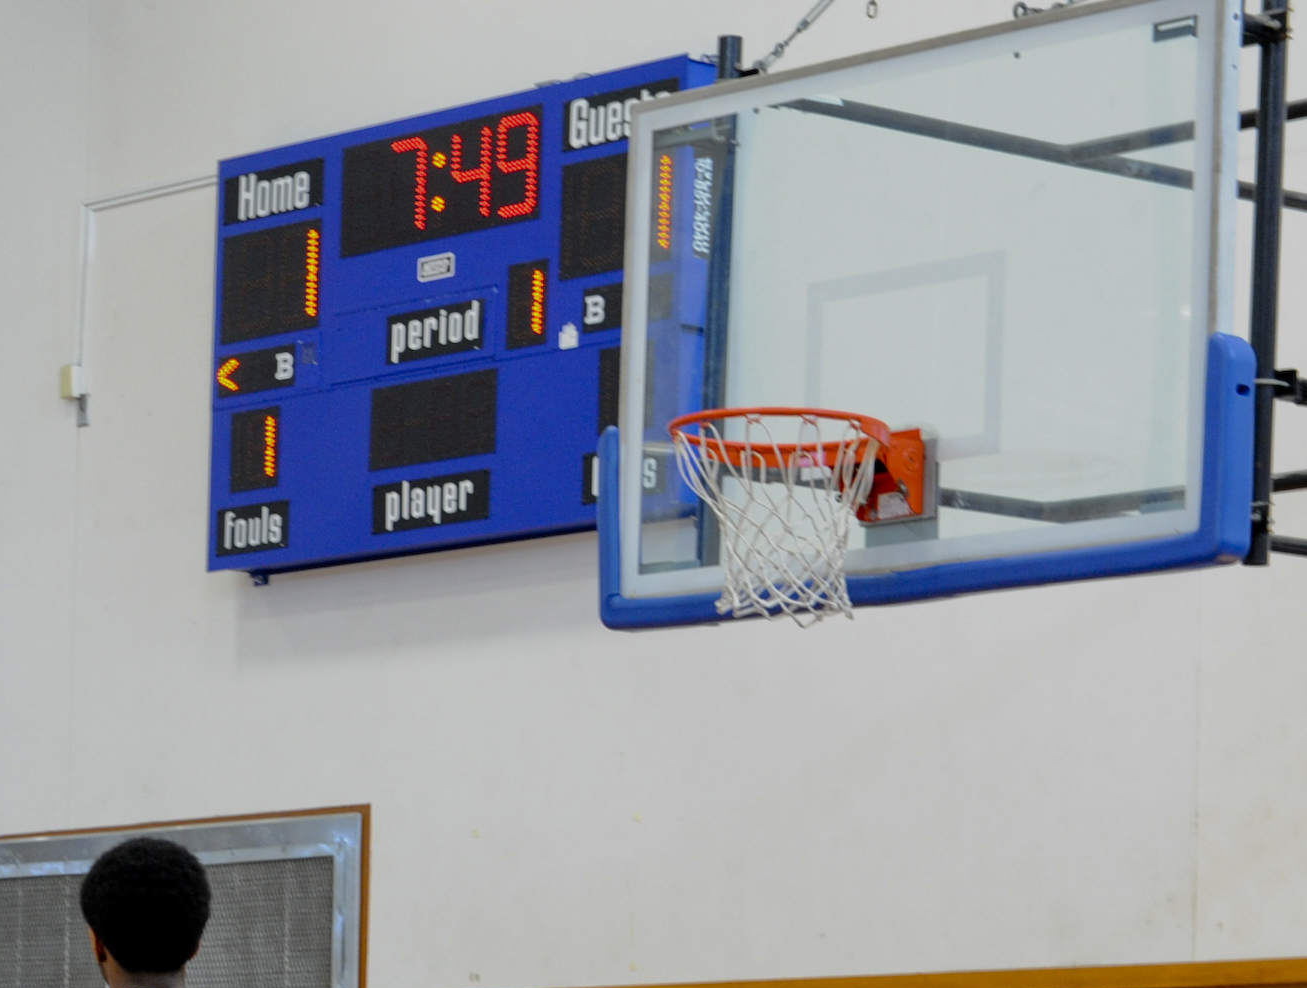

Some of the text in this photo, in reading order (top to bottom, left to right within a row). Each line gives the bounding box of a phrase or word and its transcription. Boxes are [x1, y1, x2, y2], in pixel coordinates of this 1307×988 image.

[569, 89, 673, 149] Gues
[237, 170, 311, 221] Home
[391, 111, 540, 230] 7:49
[305, 228, 320, 317] 1
[531, 269, 545, 335] 1
[391, 300, 481, 364] period
[584, 294, 605, 325] B
[275, 352, 294, 380] B
[264, 415, 277, 478] 1
[224, 506, 283, 550] fouls
[385, 479, 474, 532] player
